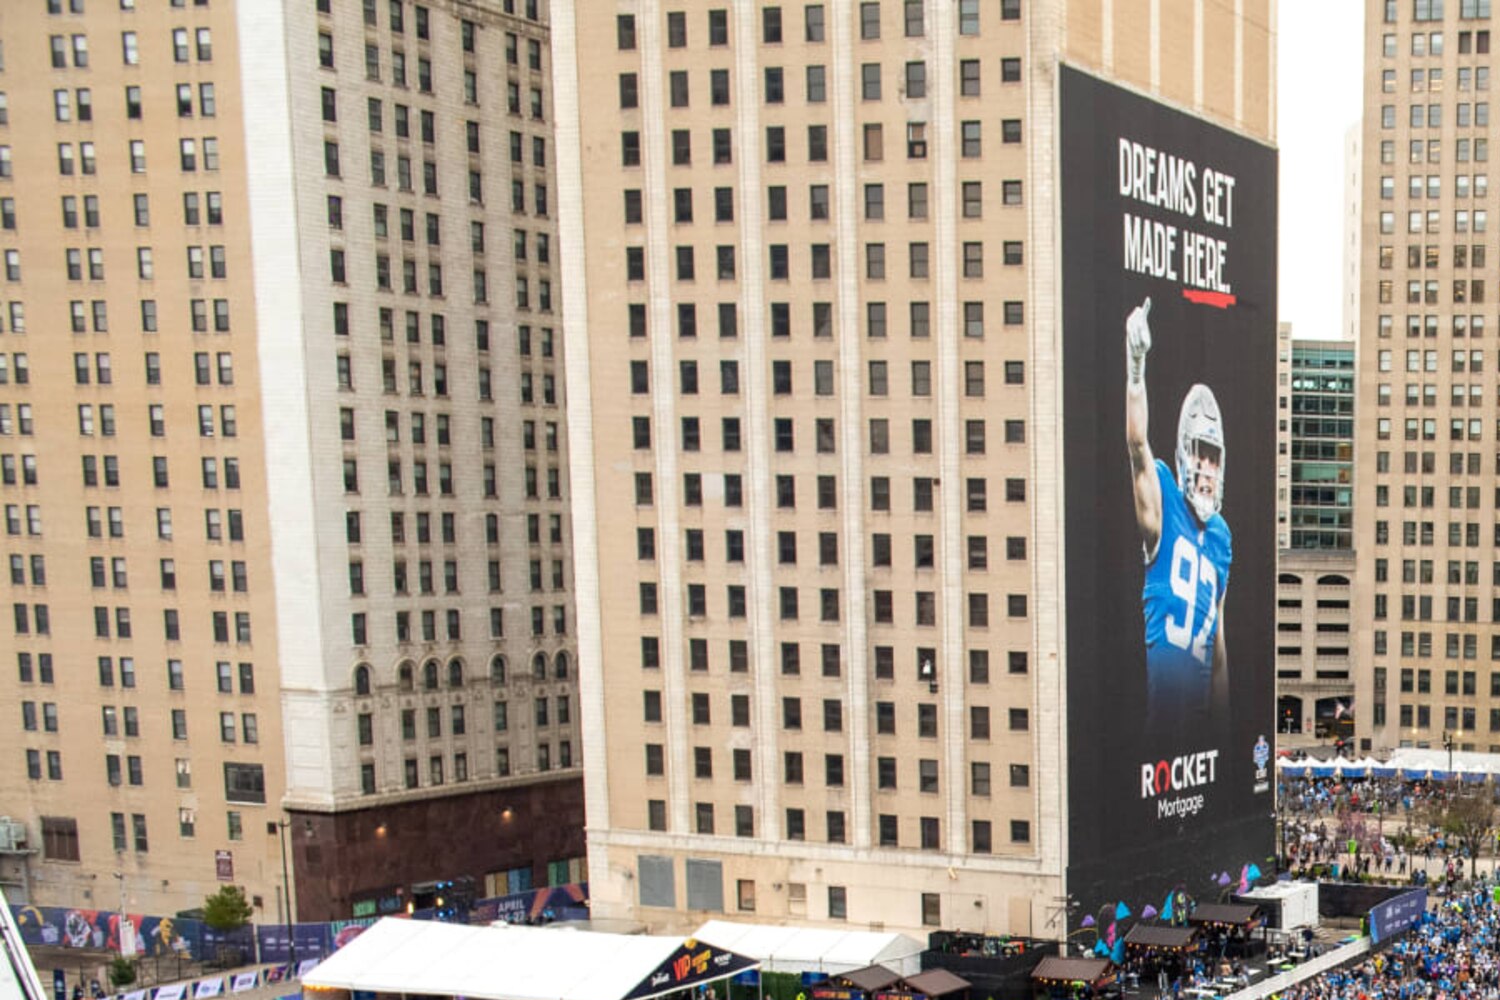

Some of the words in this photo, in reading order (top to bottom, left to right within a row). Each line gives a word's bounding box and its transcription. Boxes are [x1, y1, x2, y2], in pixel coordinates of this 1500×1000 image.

[1119, 138, 1196, 216] DREAMS
[1202, 168, 1236, 228] GET
[1123, 213, 1178, 281] MADE
[1183, 230, 1231, 293] HERE.
[1165, 535, 1217, 664] 97
[1141, 749, 1219, 798] ROCKET
[1158, 794, 1204, 818] Mortgage
[498, 899, 525, 912] APRIL
[673, 954, 691, 981] VIP
